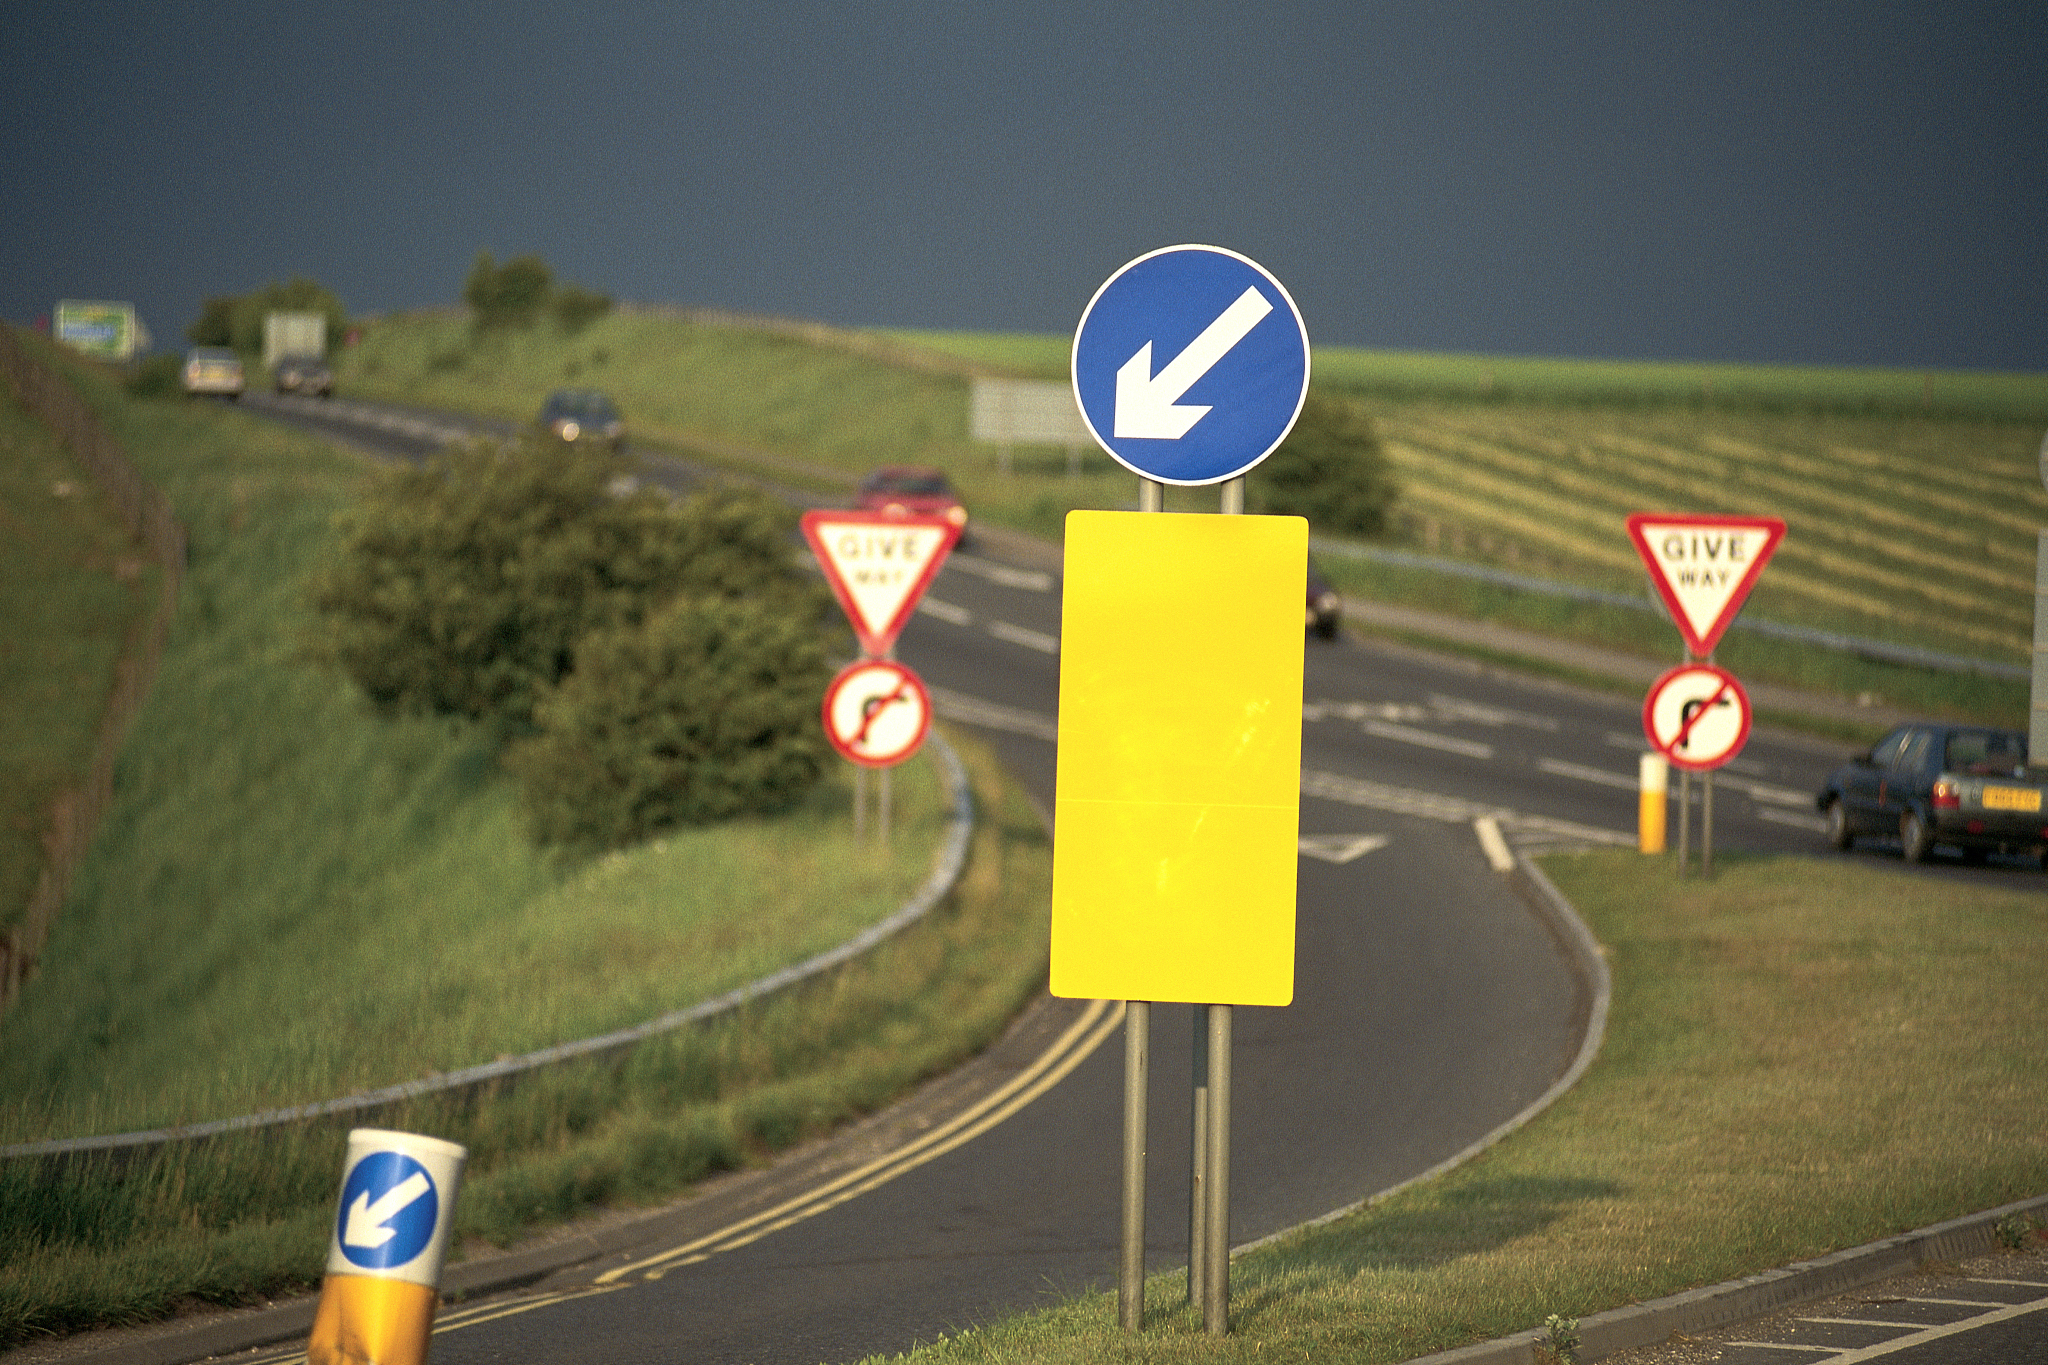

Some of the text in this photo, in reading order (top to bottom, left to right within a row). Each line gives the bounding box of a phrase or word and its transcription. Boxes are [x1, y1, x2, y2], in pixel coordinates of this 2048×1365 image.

[837, 532, 917, 562] GIVE
[1662, 534, 1745, 562] GIVE
[1678, 570, 1729, 587] WAY
